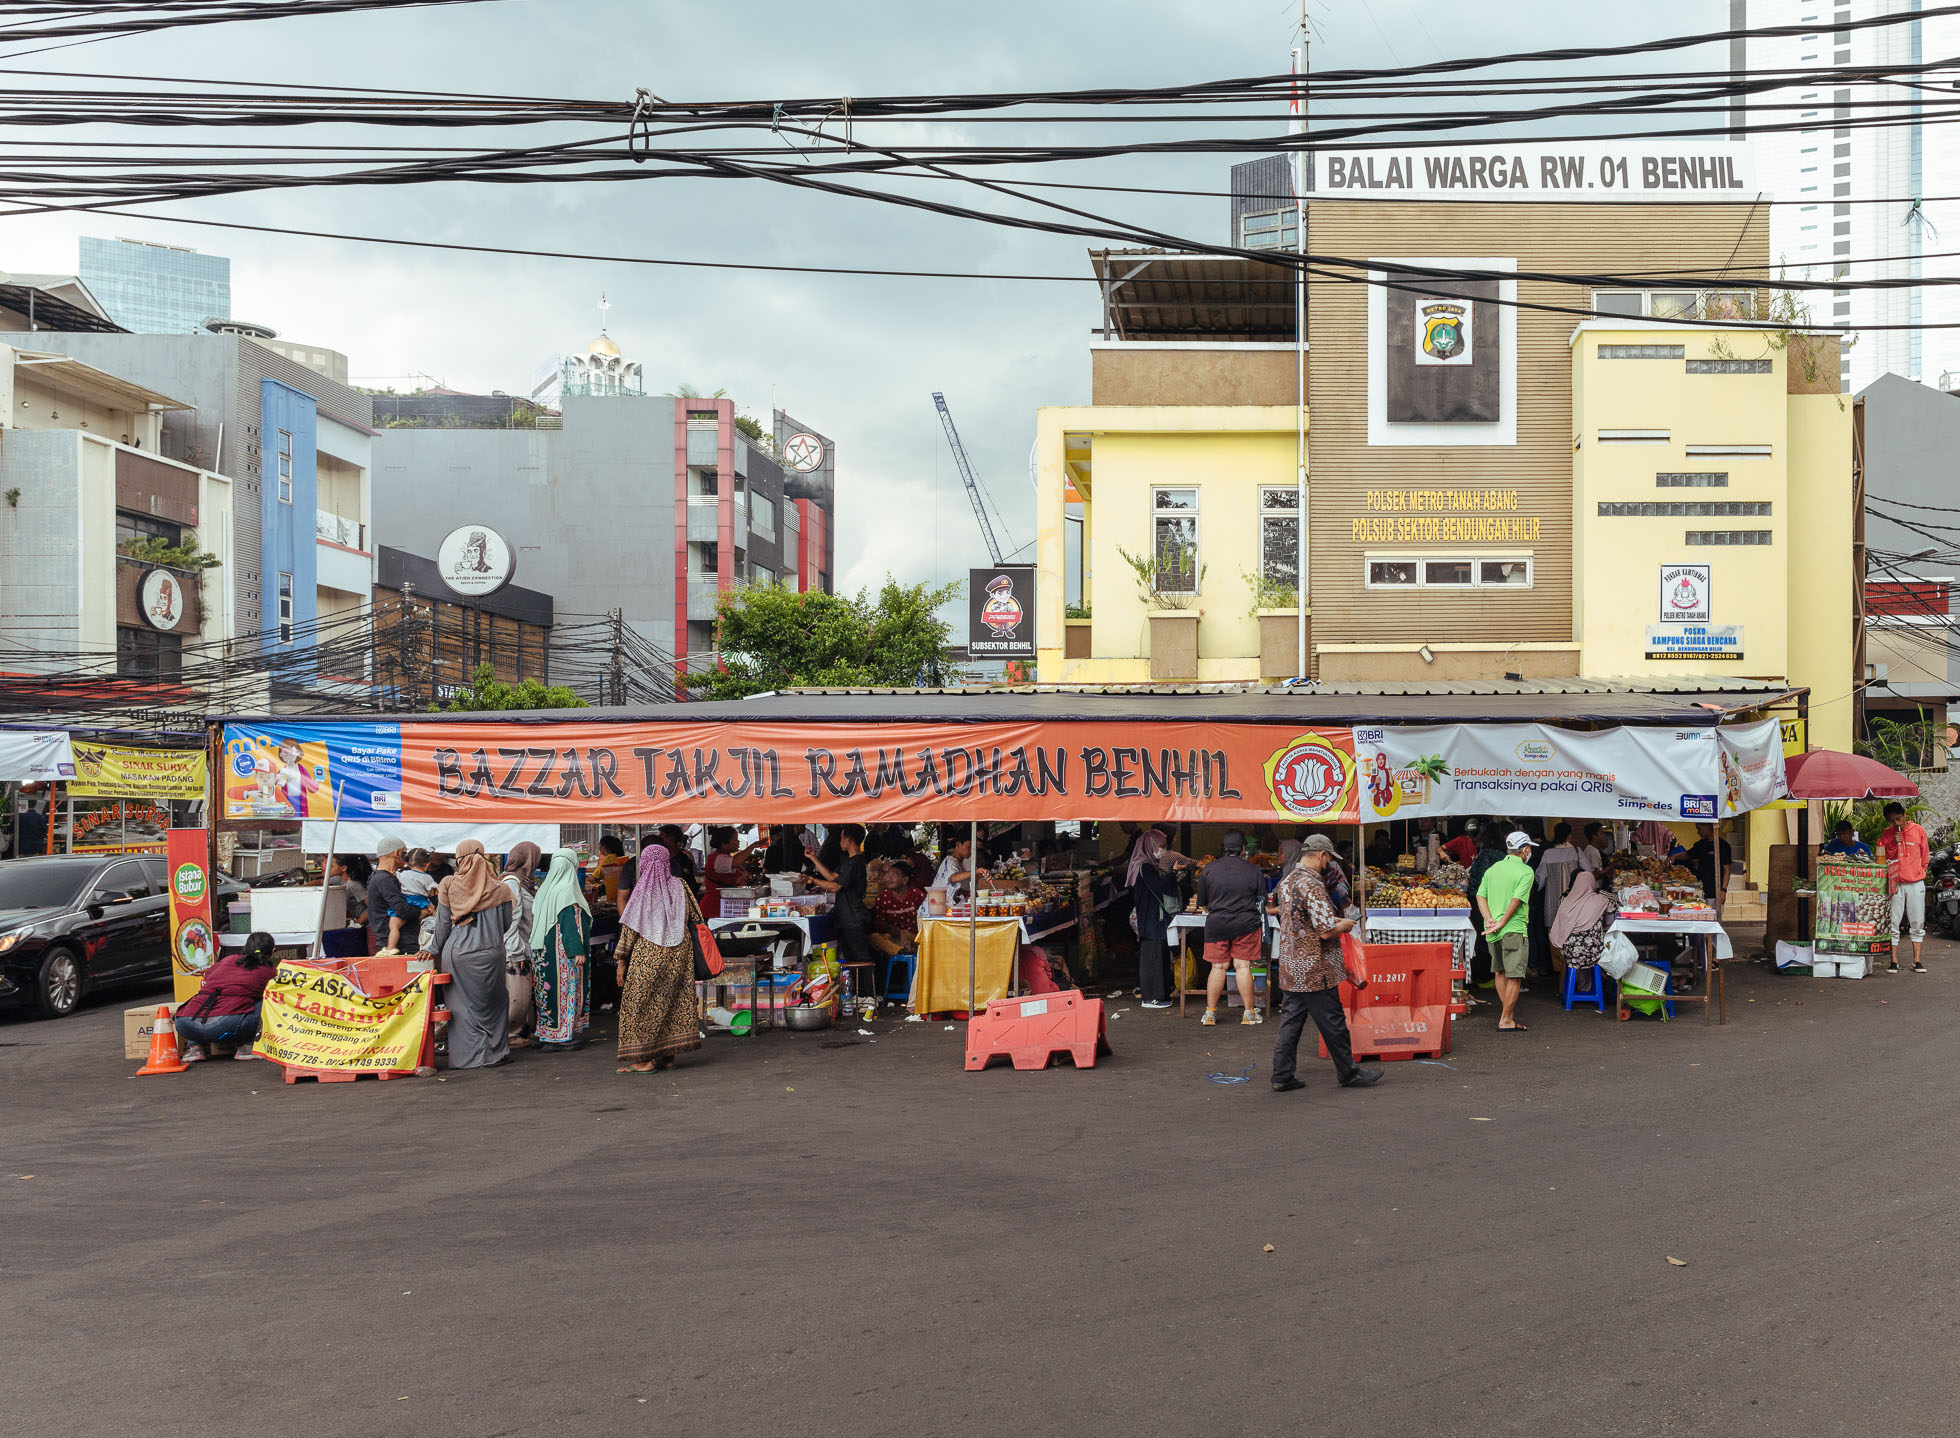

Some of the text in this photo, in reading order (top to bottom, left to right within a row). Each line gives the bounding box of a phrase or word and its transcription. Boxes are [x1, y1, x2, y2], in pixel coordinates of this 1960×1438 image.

[1328, 156, 1413, 189] BALAI
[1424, 156, 1529, 189] WARGA
[1642, 156, 1744, 189] BENHIL
[1367, 490, 1518, 511] POLSEK METRO TANAH ABANG
[1352, 516, 1541, 542] POLSUB SEKTOR BENDUNGAN HILIR
[1684, 627, 1706, 636] POSKO
[971, 641, 1032, 650] SUBSEKTOR BENHIL
[1652, 636, 1737, 645] KAMPUNG SIAGA BENCANA
[384, 726, 397, 734] BRI
[1367, 730, 1384, 740] BRI
[352, 746, 398, 755] Bayar Pake
[122, 760, 189, 772] SINAR SURYA
[341, 755, 397, 764] QRIS di BRImo
[120, 772, 194, 783] MASAKAN PADANG
[432, 746, 1243, 800] BAZZAR TAKJIL RAMADHAN BENHIL
[1454, 767, 1616, 782] Berbukalah dengan yang manis
[1453, 779, 1613, 793] Transaksinya pakai QRIS
[1617, 798, 1673, 810] Simpedes
[1684, 800, 1699, 808] BRI
[72, 803, 171, 839] SINAR SURYA
[178, 868, 202, 881] Istana
[1824, 865, 1874, 878] OTAK-OTAK
[178, 880, 202, 894] Bubur
[274, 968, 307, 988] EG
[292, 1013, 318, 1025] Ayam
[320, 1020, 353, 1032] Goreng
[286, 1024, 314, 1036] Ayam
[315, 1029, 360, 1044] Panggang
[292, 1041, 332, 1053] LEZAT
[278, 1048, 301, 1061] 9957
[300, 1054, 320, 1065] 726
[348, 1058, 372, 1067] 1749
[374, 1058, 398, 1067] 9339
